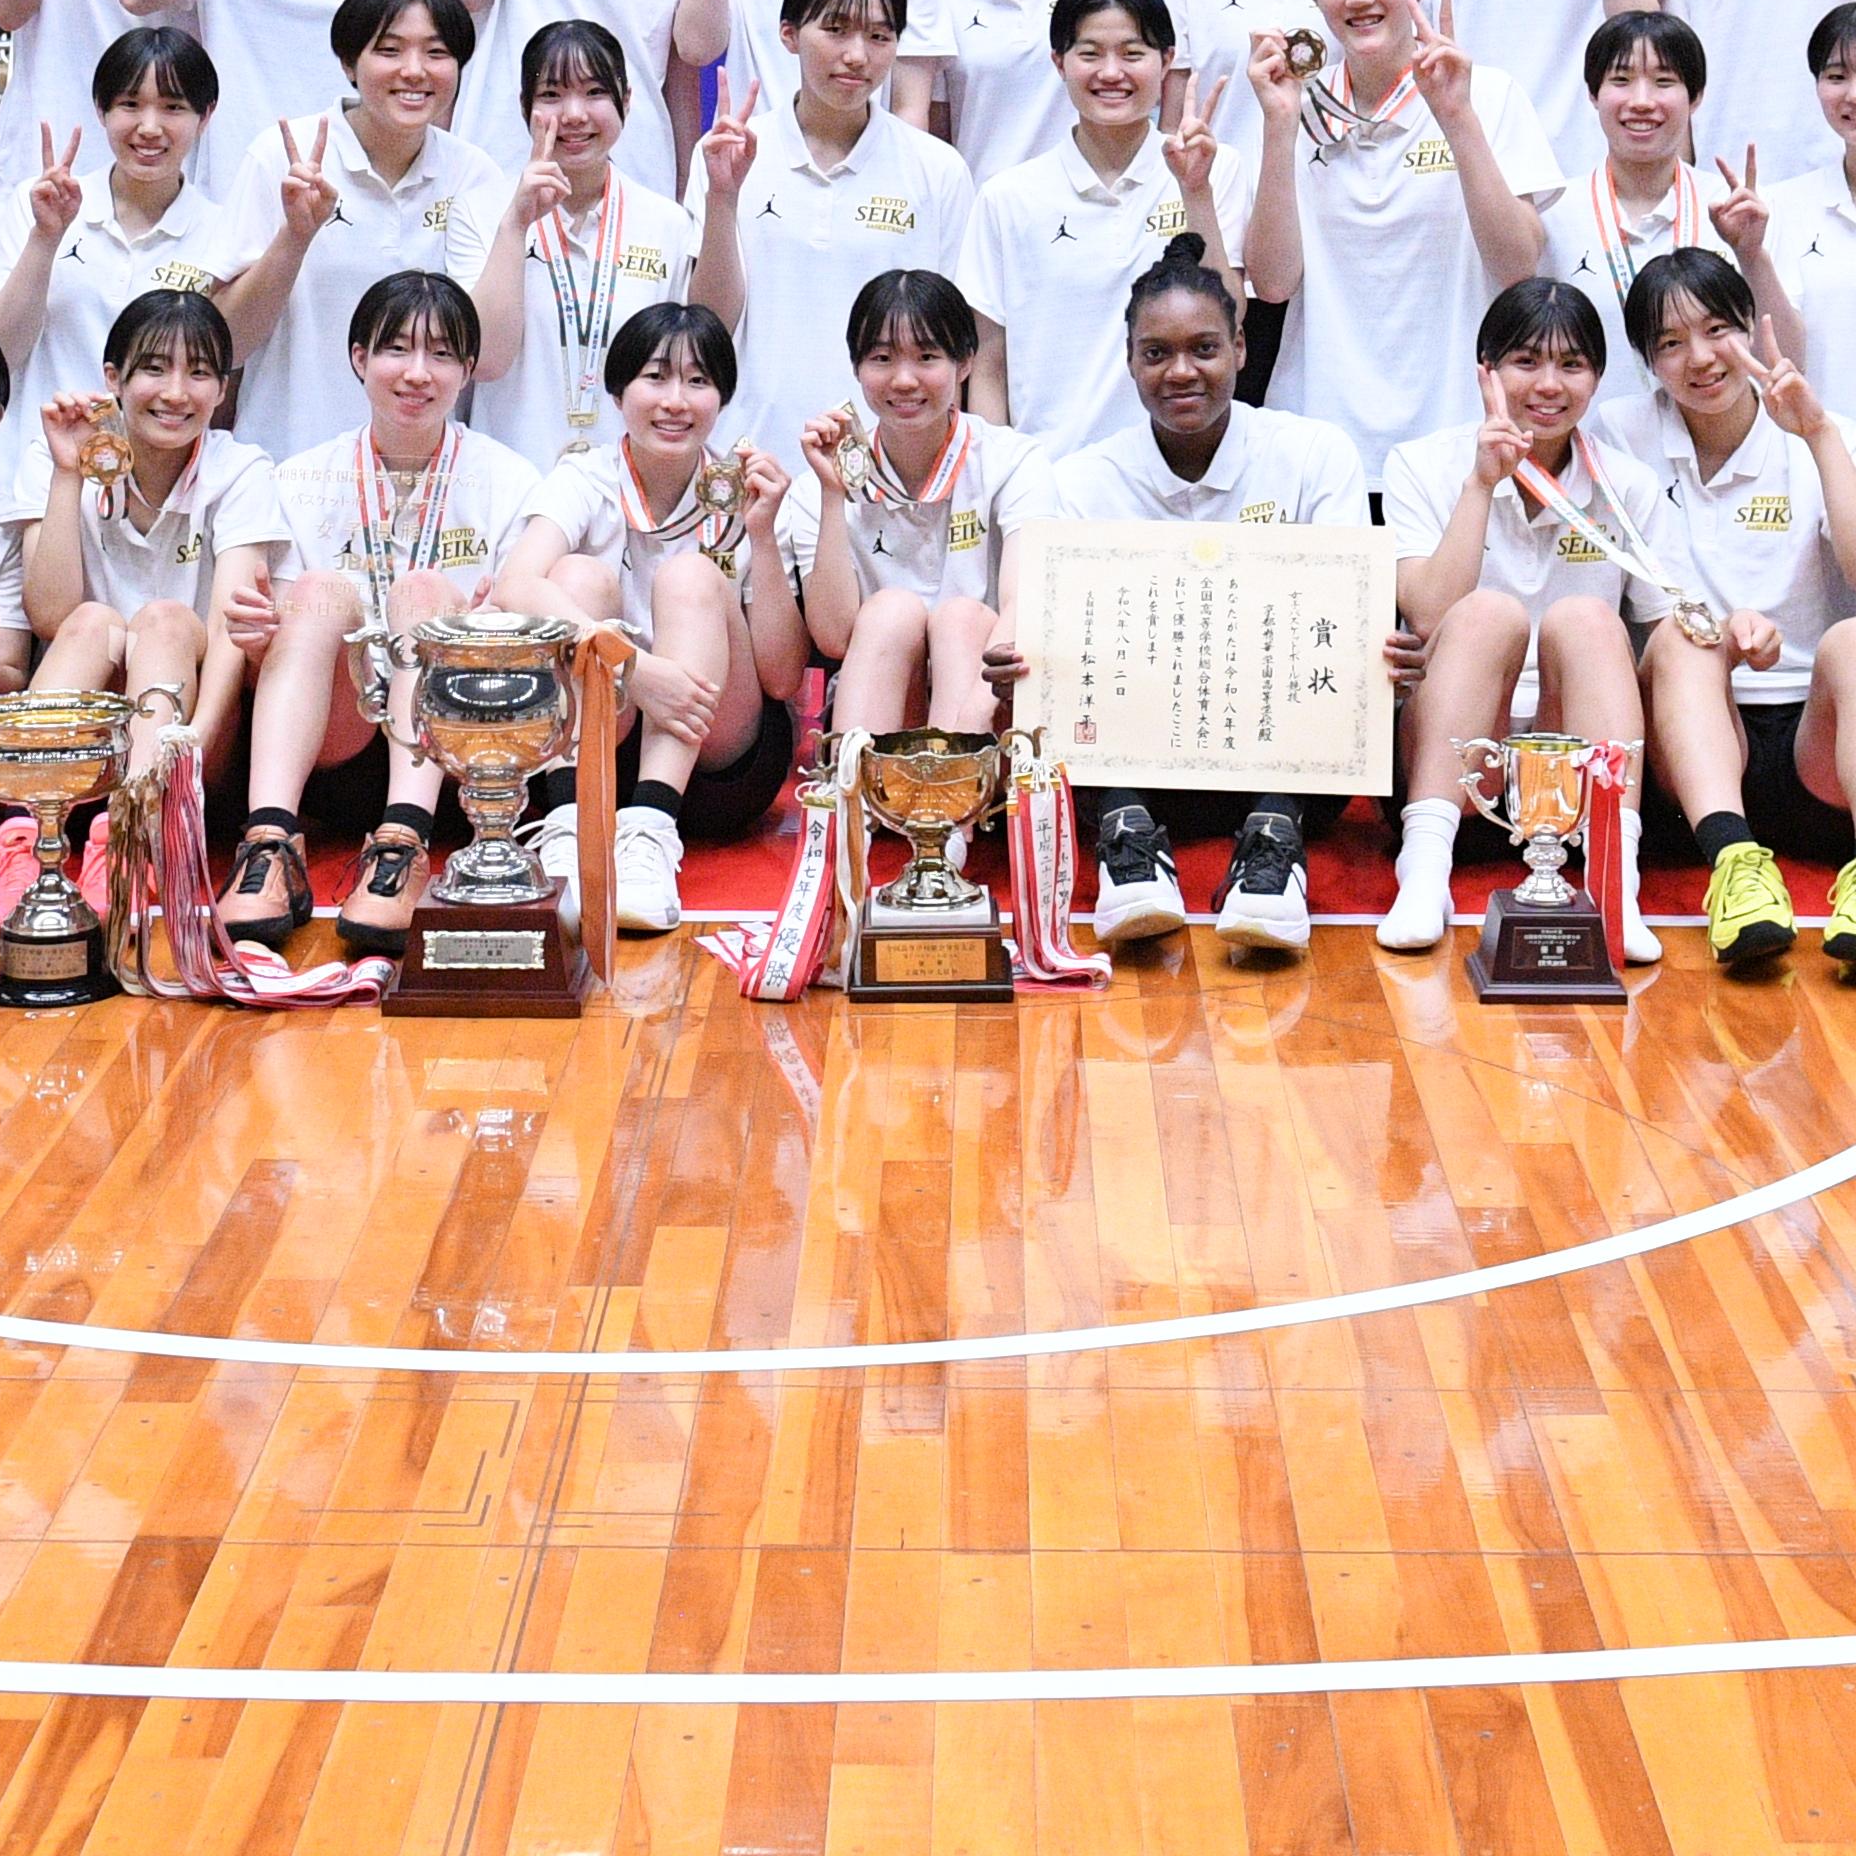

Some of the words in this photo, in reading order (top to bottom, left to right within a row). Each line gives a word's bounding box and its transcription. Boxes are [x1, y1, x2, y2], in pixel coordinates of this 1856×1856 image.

[1403, 149, 1451, 169] SEIK
[871, 196, 909, 210] KYOTO
[855, 205, 915, 230] SEIKA
[441, 527, 477, 542] KYOTO
[1307, 616, 1338, 695] 賞状
